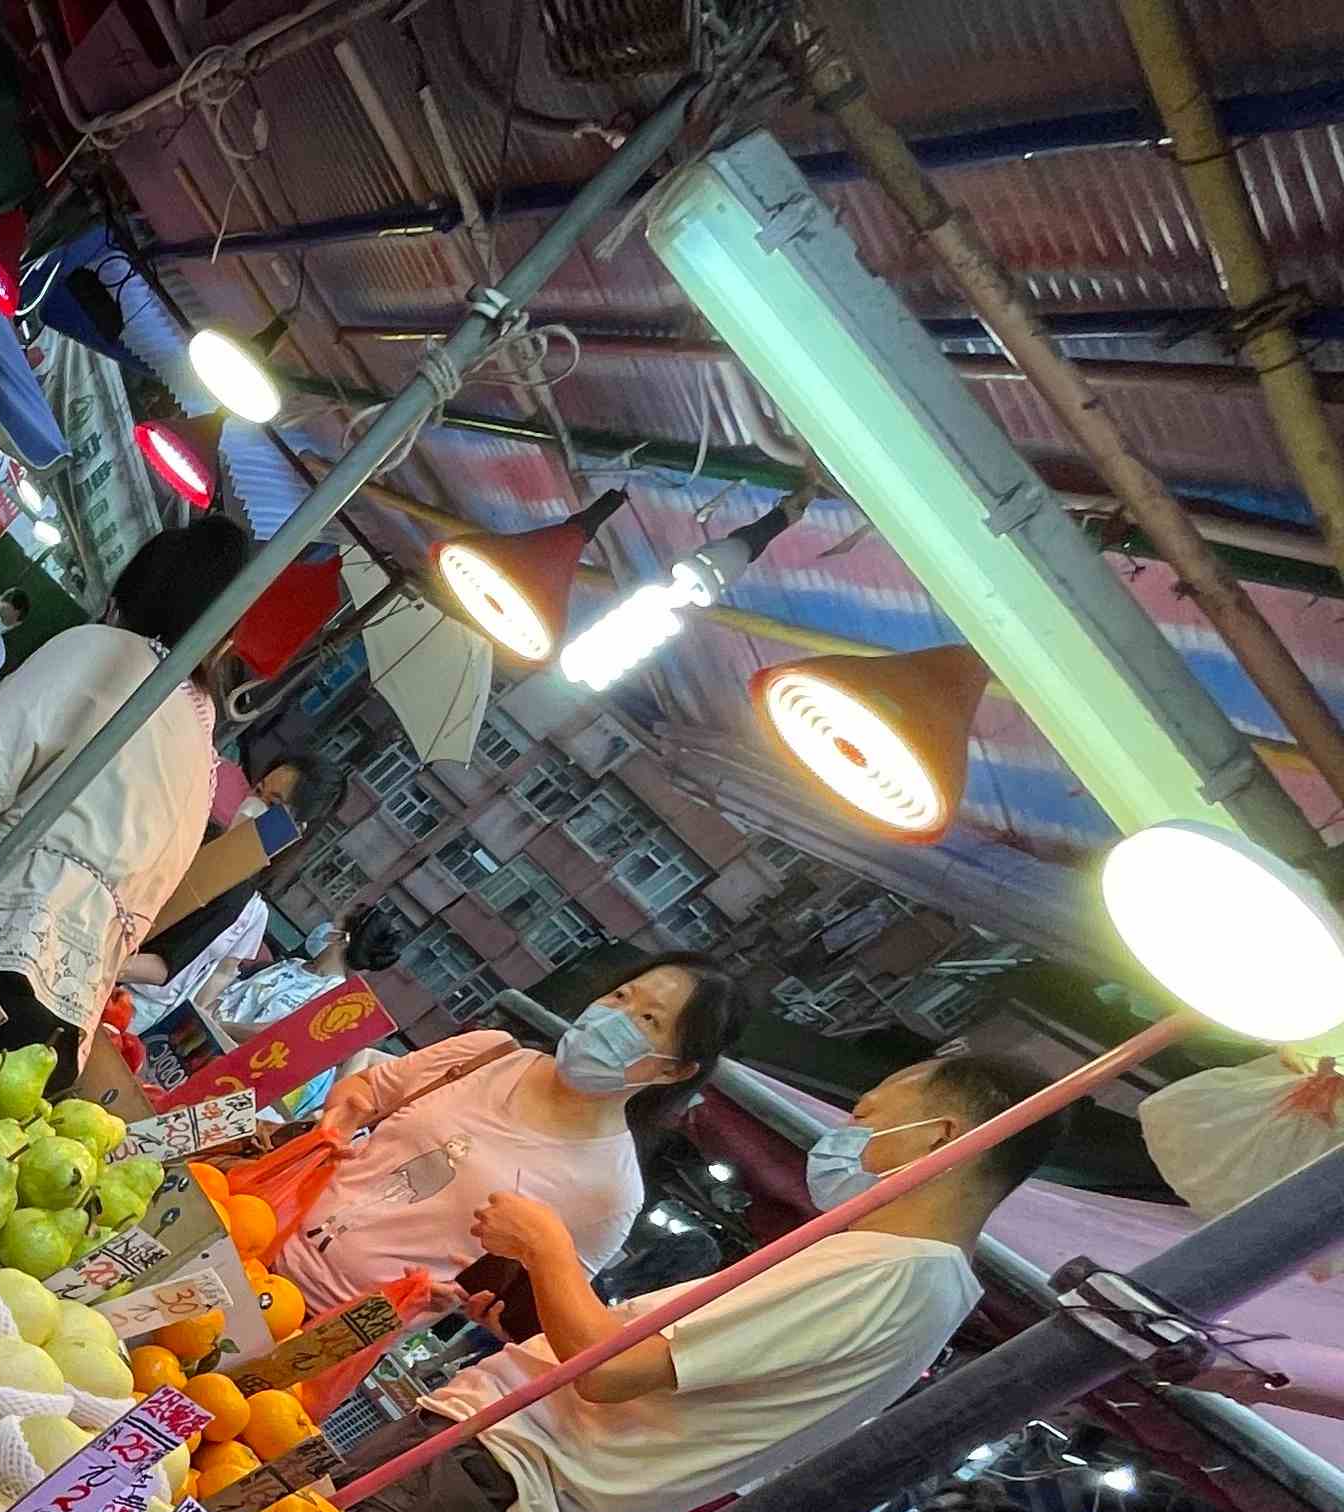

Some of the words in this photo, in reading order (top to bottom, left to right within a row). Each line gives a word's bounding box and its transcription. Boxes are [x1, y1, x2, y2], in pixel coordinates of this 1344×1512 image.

[166, 1121, 193, 1151] 20
[156, 1289, 201, 1315] 30
[110, 1433, 154, 1463] 25
[78, 1461, 118, 1488] 元
[50, 1484, 93, 1512] 2
